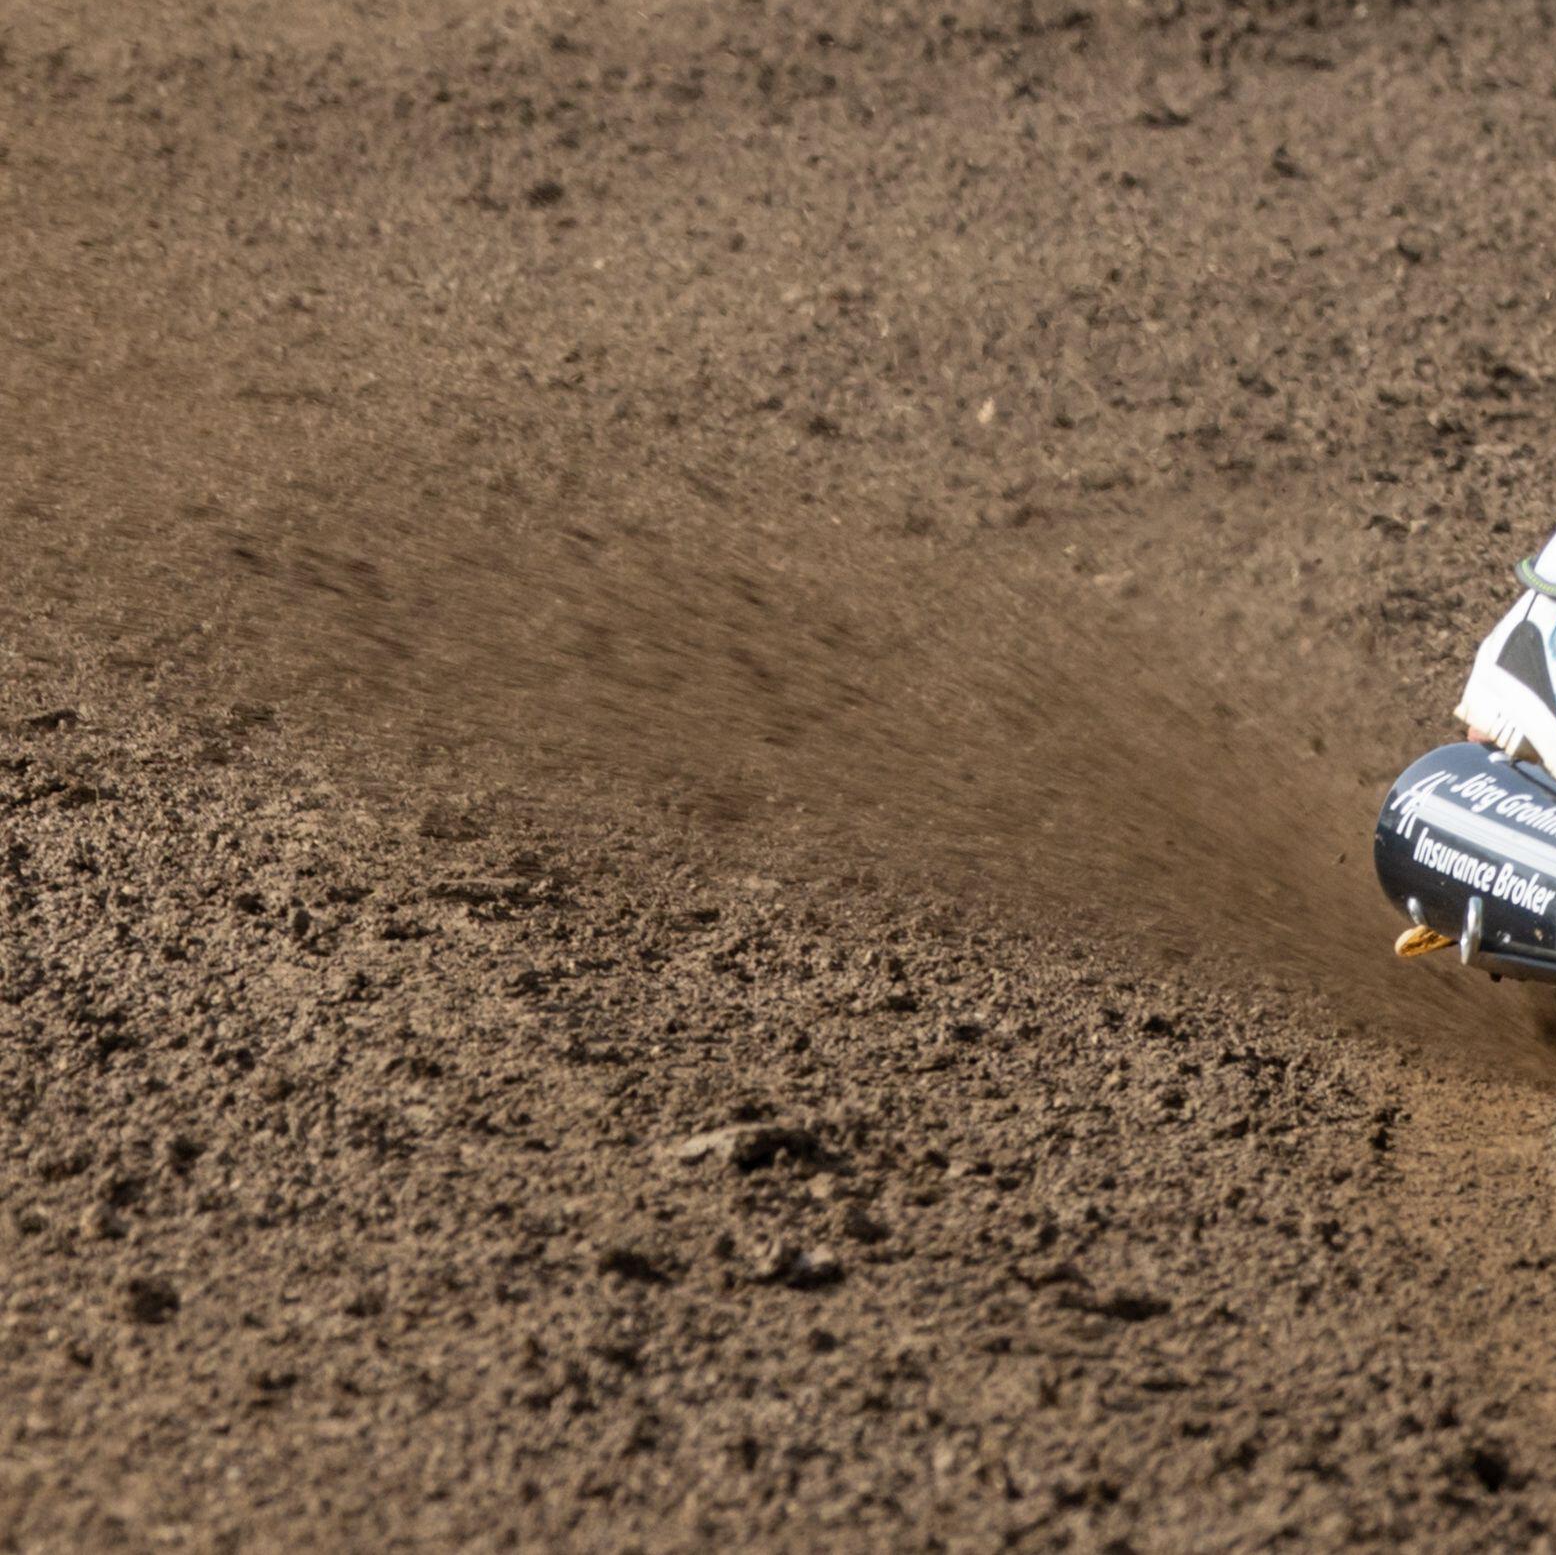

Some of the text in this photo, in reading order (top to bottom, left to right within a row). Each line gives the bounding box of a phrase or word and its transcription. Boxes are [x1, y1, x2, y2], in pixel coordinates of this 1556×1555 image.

[1450, 770, 1507, 818] Jörg
[1413, 824, 1556, 918] Insurance Broker
